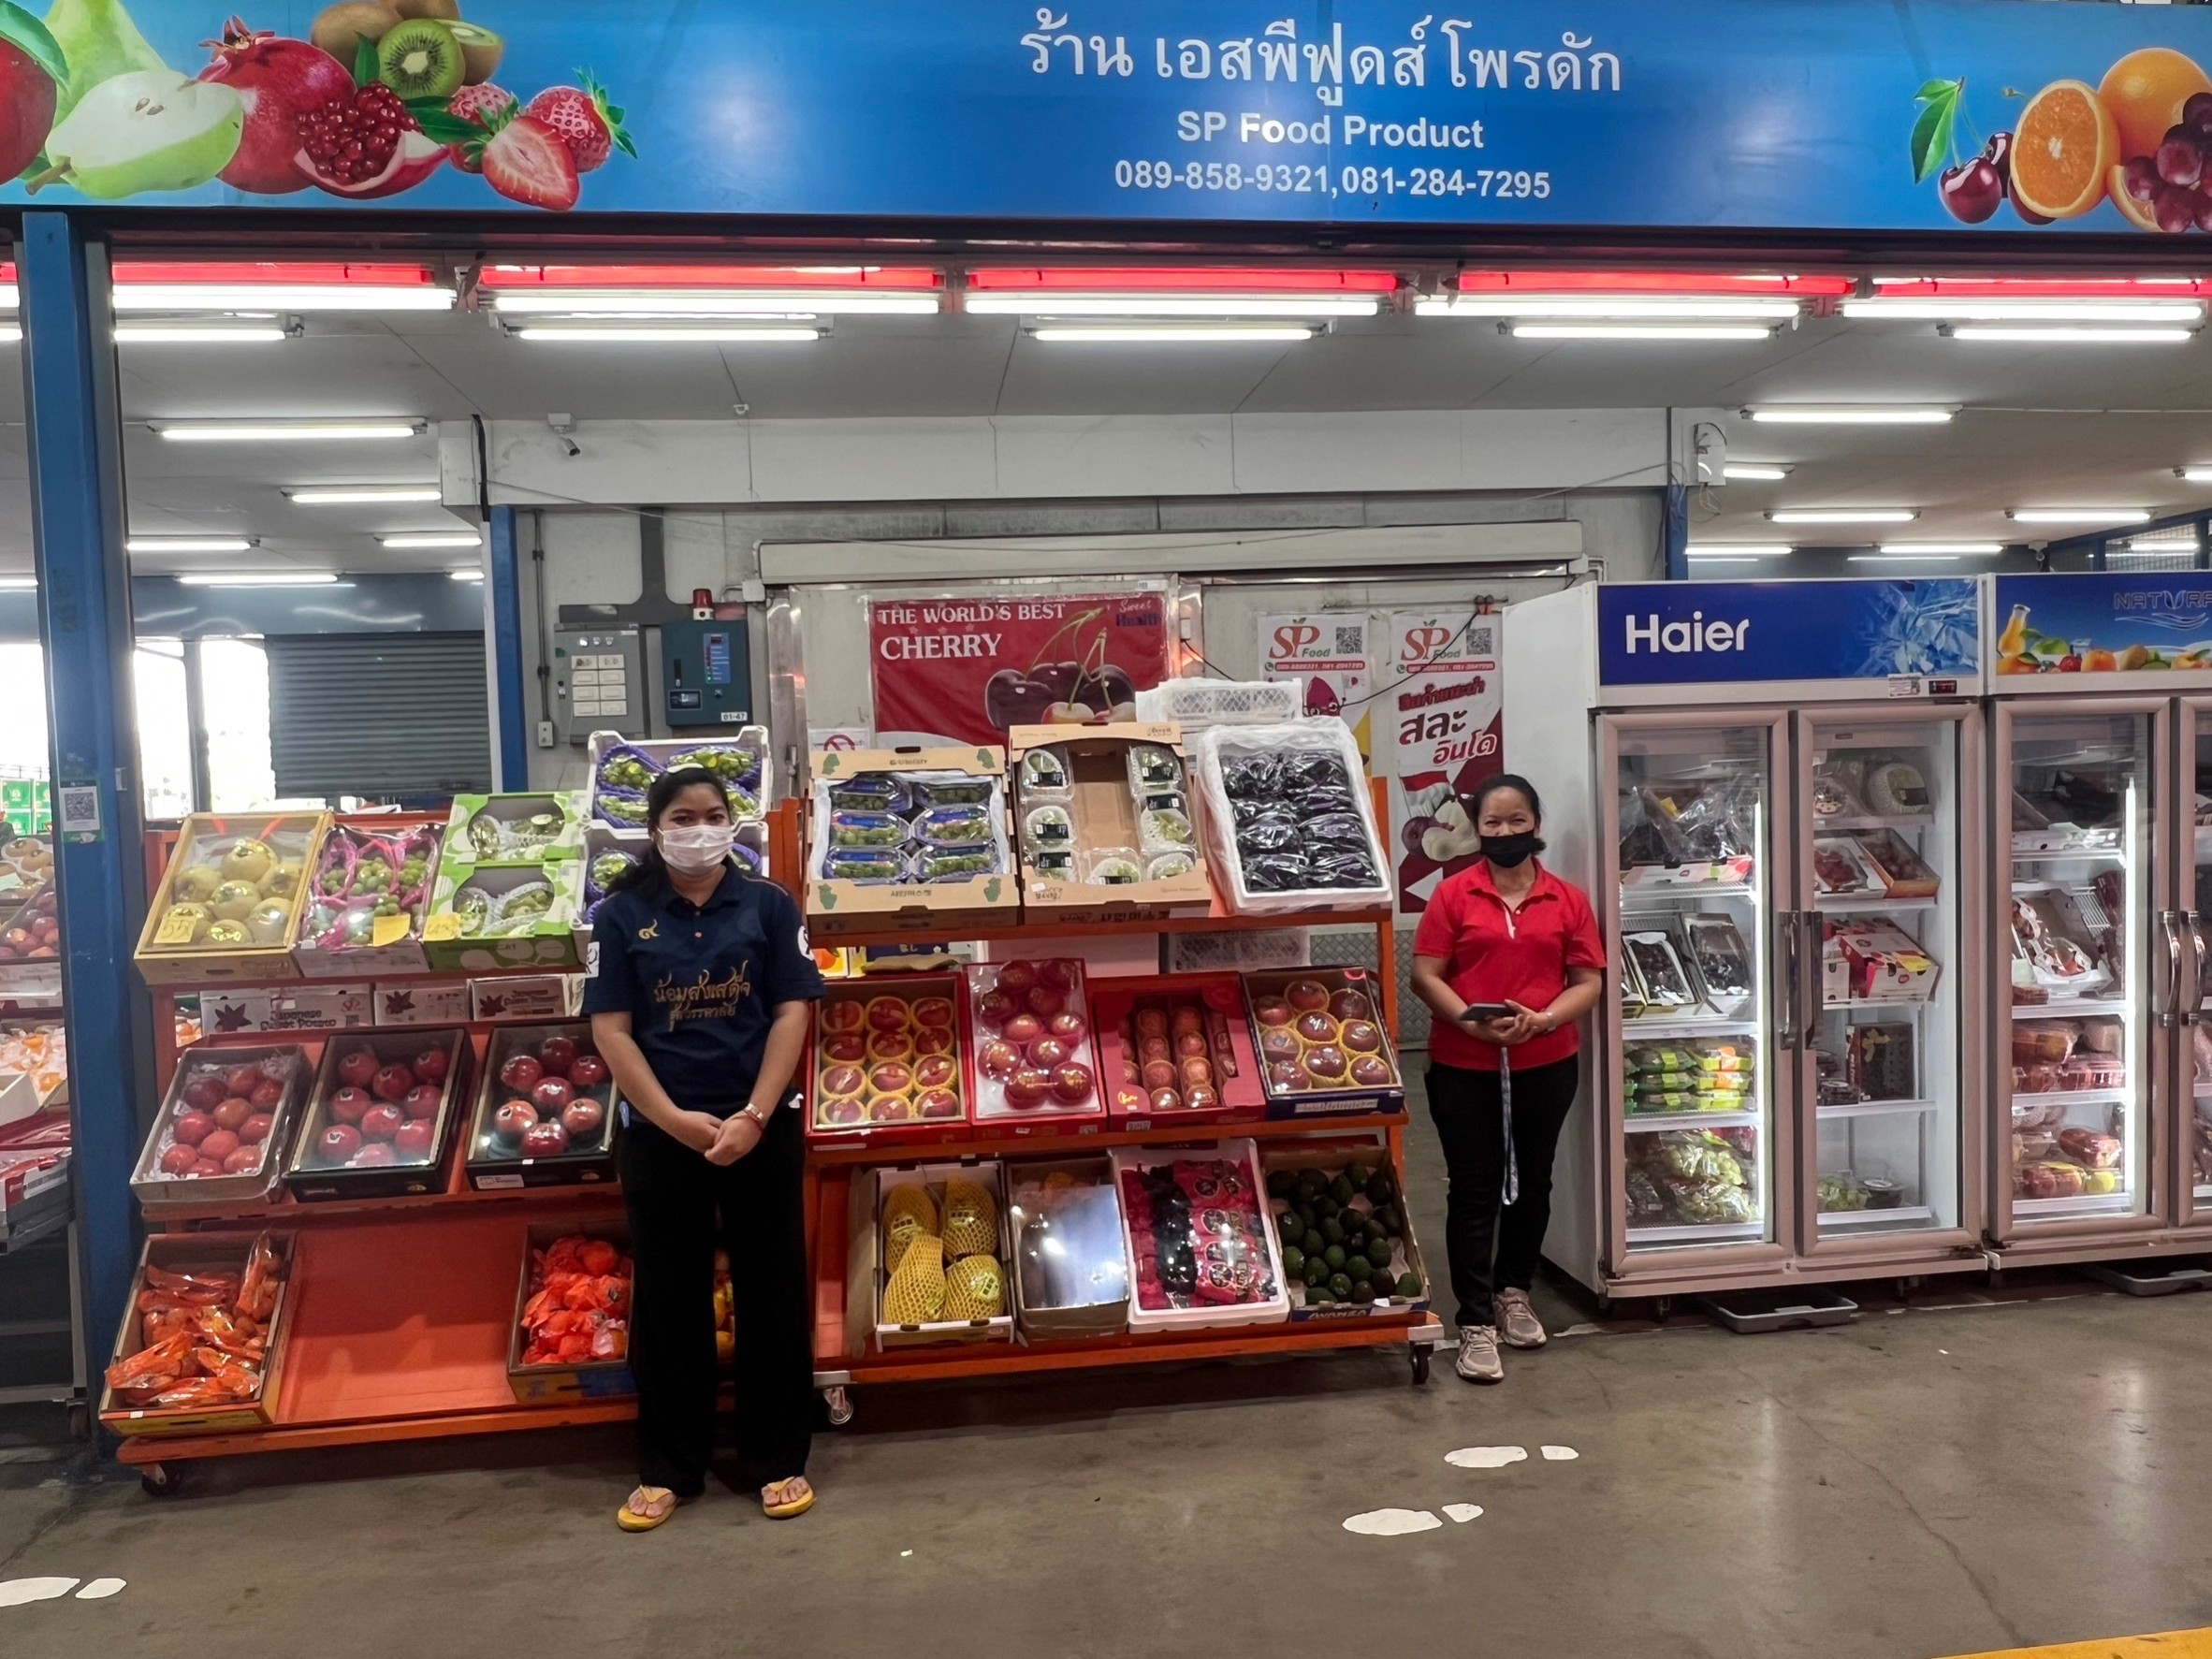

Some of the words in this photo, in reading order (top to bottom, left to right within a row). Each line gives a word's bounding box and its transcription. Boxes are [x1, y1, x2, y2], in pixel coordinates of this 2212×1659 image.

[1021, 7, 1133, 77] ร้าน
[1157, 15, 1433, 106] เอสพีฟูดส์
[1441, 20, 1620, 91] โพรดัก
[1177, 110, 1226, 141] SP
[1241, 113, 1331, 145] Food
[1344, 115, 1484, 149] Product
[877, 609, 918, 624] THE
[923, 605, 1011, 623] WORLD'S
[1018, 604, 1066, 620] BEST
[880, 633, 1003, 661] CHERRY
[1269, 626, 1320, 659] SP
[1401, 627, 1450, 661] SP
[1625, 611, 1750, 654] Haier
[1302, 648, 1331, 658] Food
[1433, 648, 1462, 660] Food
[1399, 709, 1468, 745] สละ
